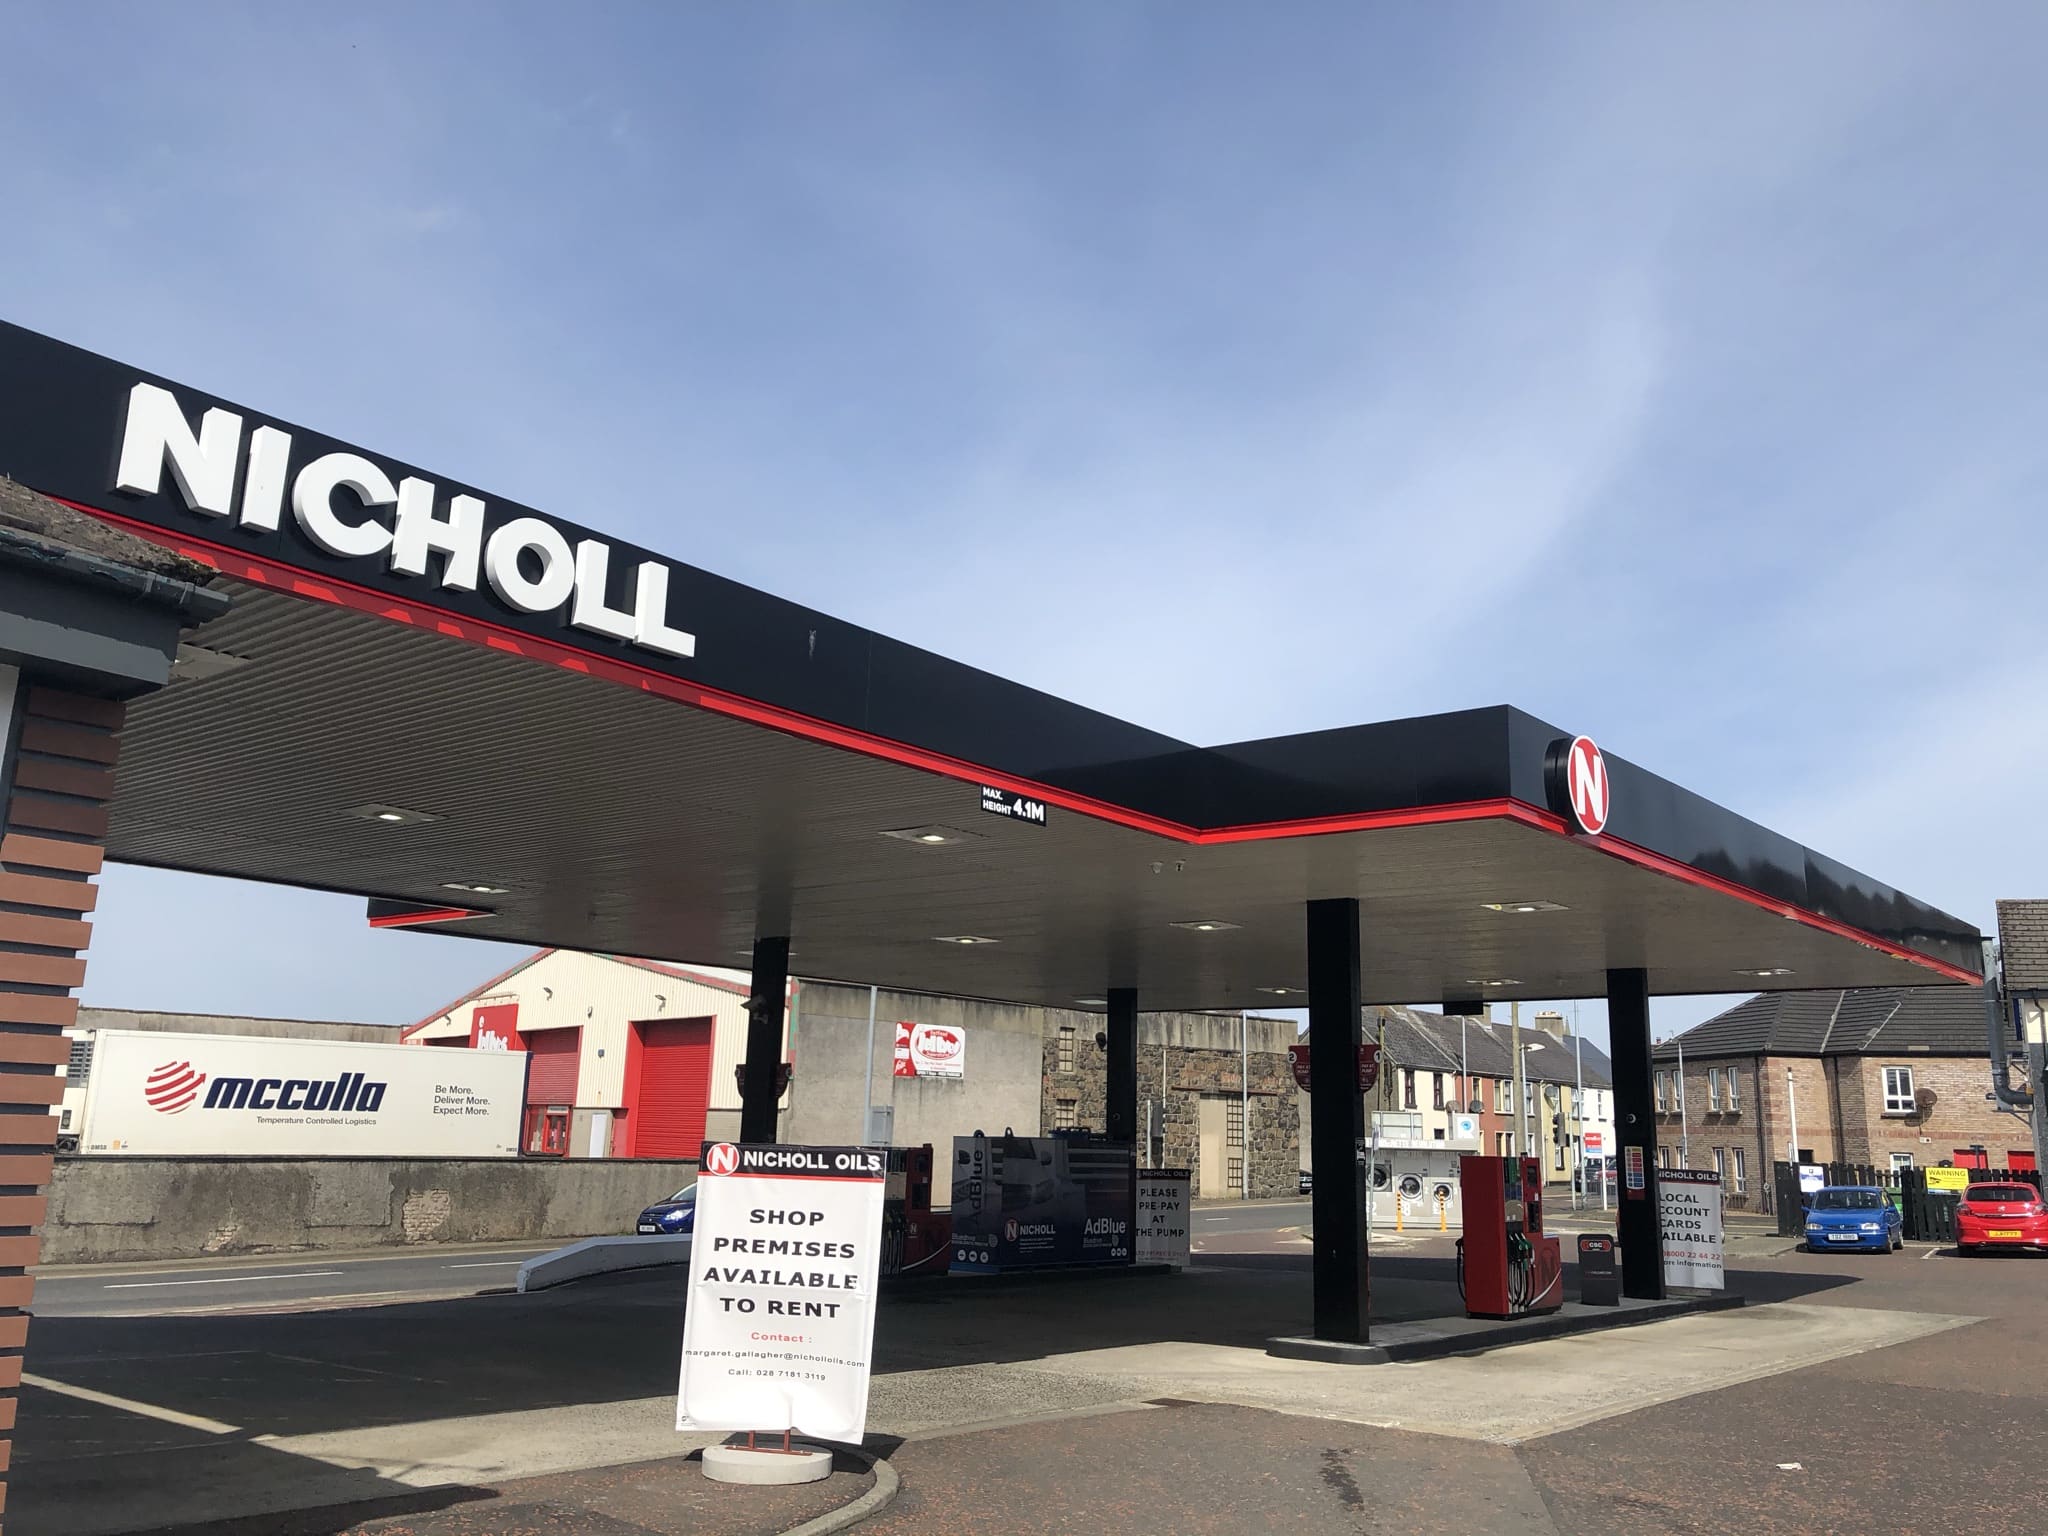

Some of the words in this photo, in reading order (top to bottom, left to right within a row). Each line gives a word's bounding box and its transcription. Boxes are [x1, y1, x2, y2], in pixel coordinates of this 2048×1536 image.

[116, 382, 695, 658] NICHOLL
[1575, 745, 1603, 823] N
[982, 786, 1003, 800] MAX.
[982, 799, 1012, 815] HEIGHT
[1013, 798, 1044, 822] 4.1M
[1289, 1053, 1295, 1061] 2
[202, 1072, 387, 1112] mcculla
[435, 1085, 447, 1094] Be
[449, 1085, 474, 1095] More.
[434, 1095, 464, 1105] Deliver
[466, 1096, 491, 1106] More.
[433, 1106, 463, 1116] Expect
[465, 1107, 490, 1116] More.
[256, 1116, 303, 1126] Temperature
[305, 1116, 343, 1126] Controlled
[344, 1117, 377, 1126] Logistics
[711, 1147, 735, 1171] N
[743, 1151, 829, 1169] NICHOLL
[835, 1154, 881, 1171] OILS
[1697, 1172, 1718, 1181] OILS
[1928, 1169, 1966, 1177] WARNING
[969, 1149, 984, 1227] AdBlue
[1140, 1188, 1177, 1197] PLEASE
[1139, 1202, 1180, 1210] PRE-PAY
[1660, 1206, 1710, 1217] CCOUNT
[749, 1208, 825, 1226] SHOP
[1152, 1215, 1165, 1223] AT
[1020, 1224, 1056, 1235] NICHOLL
[1084, 1218, 1126, 1235] AdBlue
[1660, 1219, 1701, 1229] CARDS
[1136, 1228, 1152, 1237] THE
[1157, 1229, 1184, 1237] PUMP
[1662, 1232, 1716, 1243] AILABLE
[713, 1237, 855, 1259] PREMISES
[1676, 1260, 1722, 1269] information
[703, 1267, 858, 1289] AVAILABLE
[719, 1297, 756, 1313] TO
[768, 1300, 841, 1318] RENT
[751, 1332, 804, 1343] Contact
[685, 1349, 865, 1368] margaret.gallagher@nicholloils.com
[728, 1368, 752, 1377] Call:
[756, 1369, 774, 1377] 028
[778, 1370, 801, 1378] 7181
[805, 1373, 826, 1381] 3119
